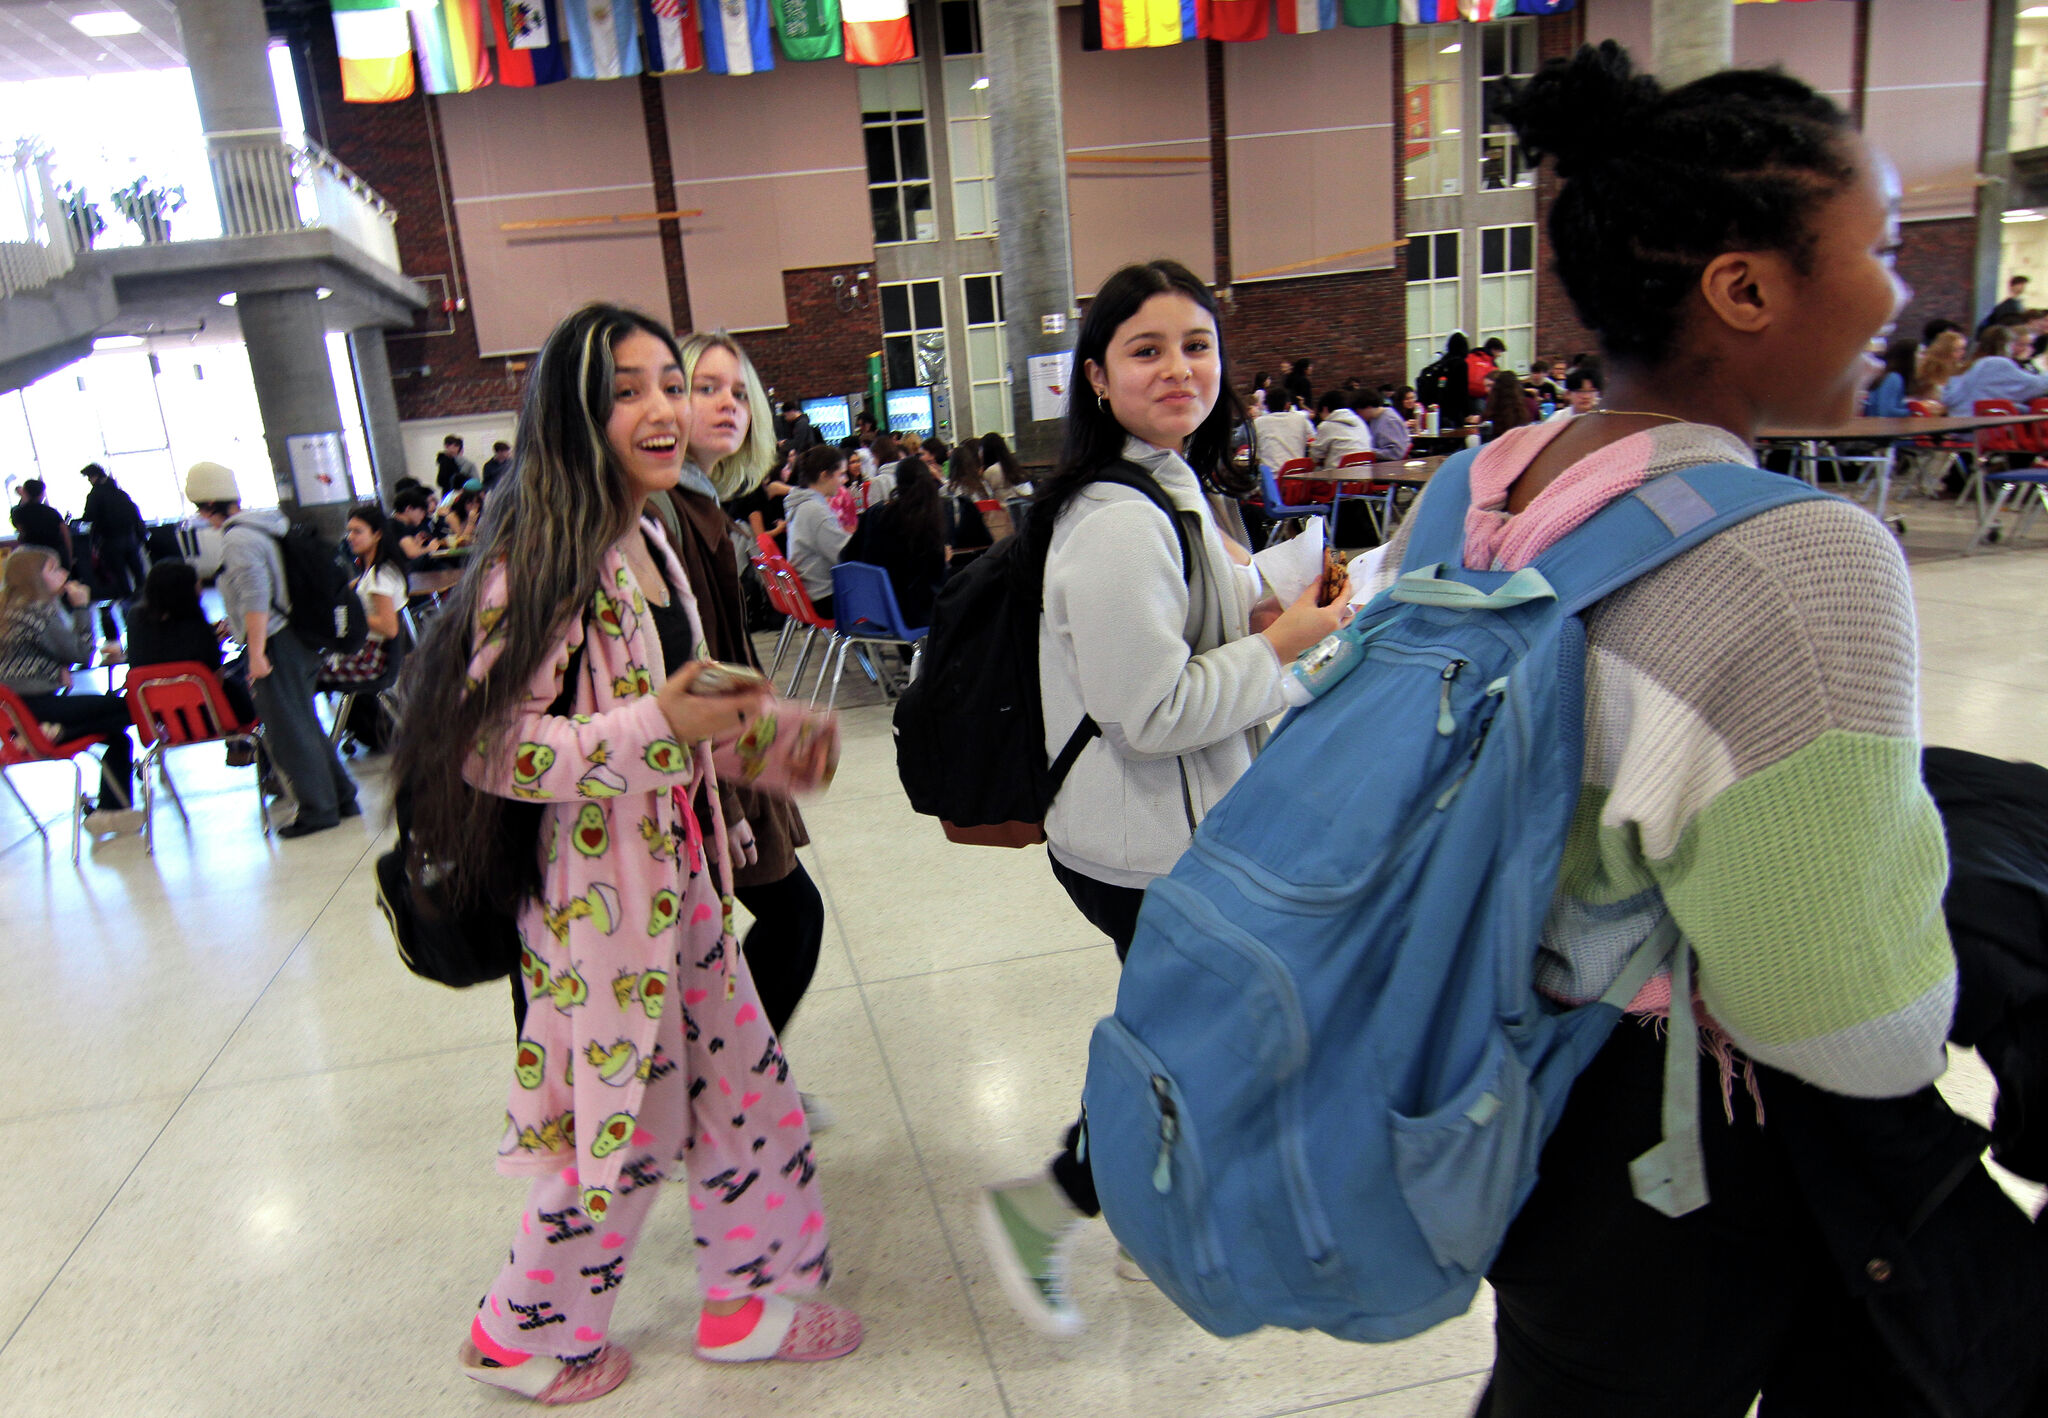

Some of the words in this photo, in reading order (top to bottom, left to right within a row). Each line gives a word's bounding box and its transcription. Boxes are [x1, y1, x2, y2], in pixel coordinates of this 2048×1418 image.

[507, 1298, 552, 1313] love
[518, 1313, 566, 1331] sleep
[526, 1312, 540, 1322] 2
